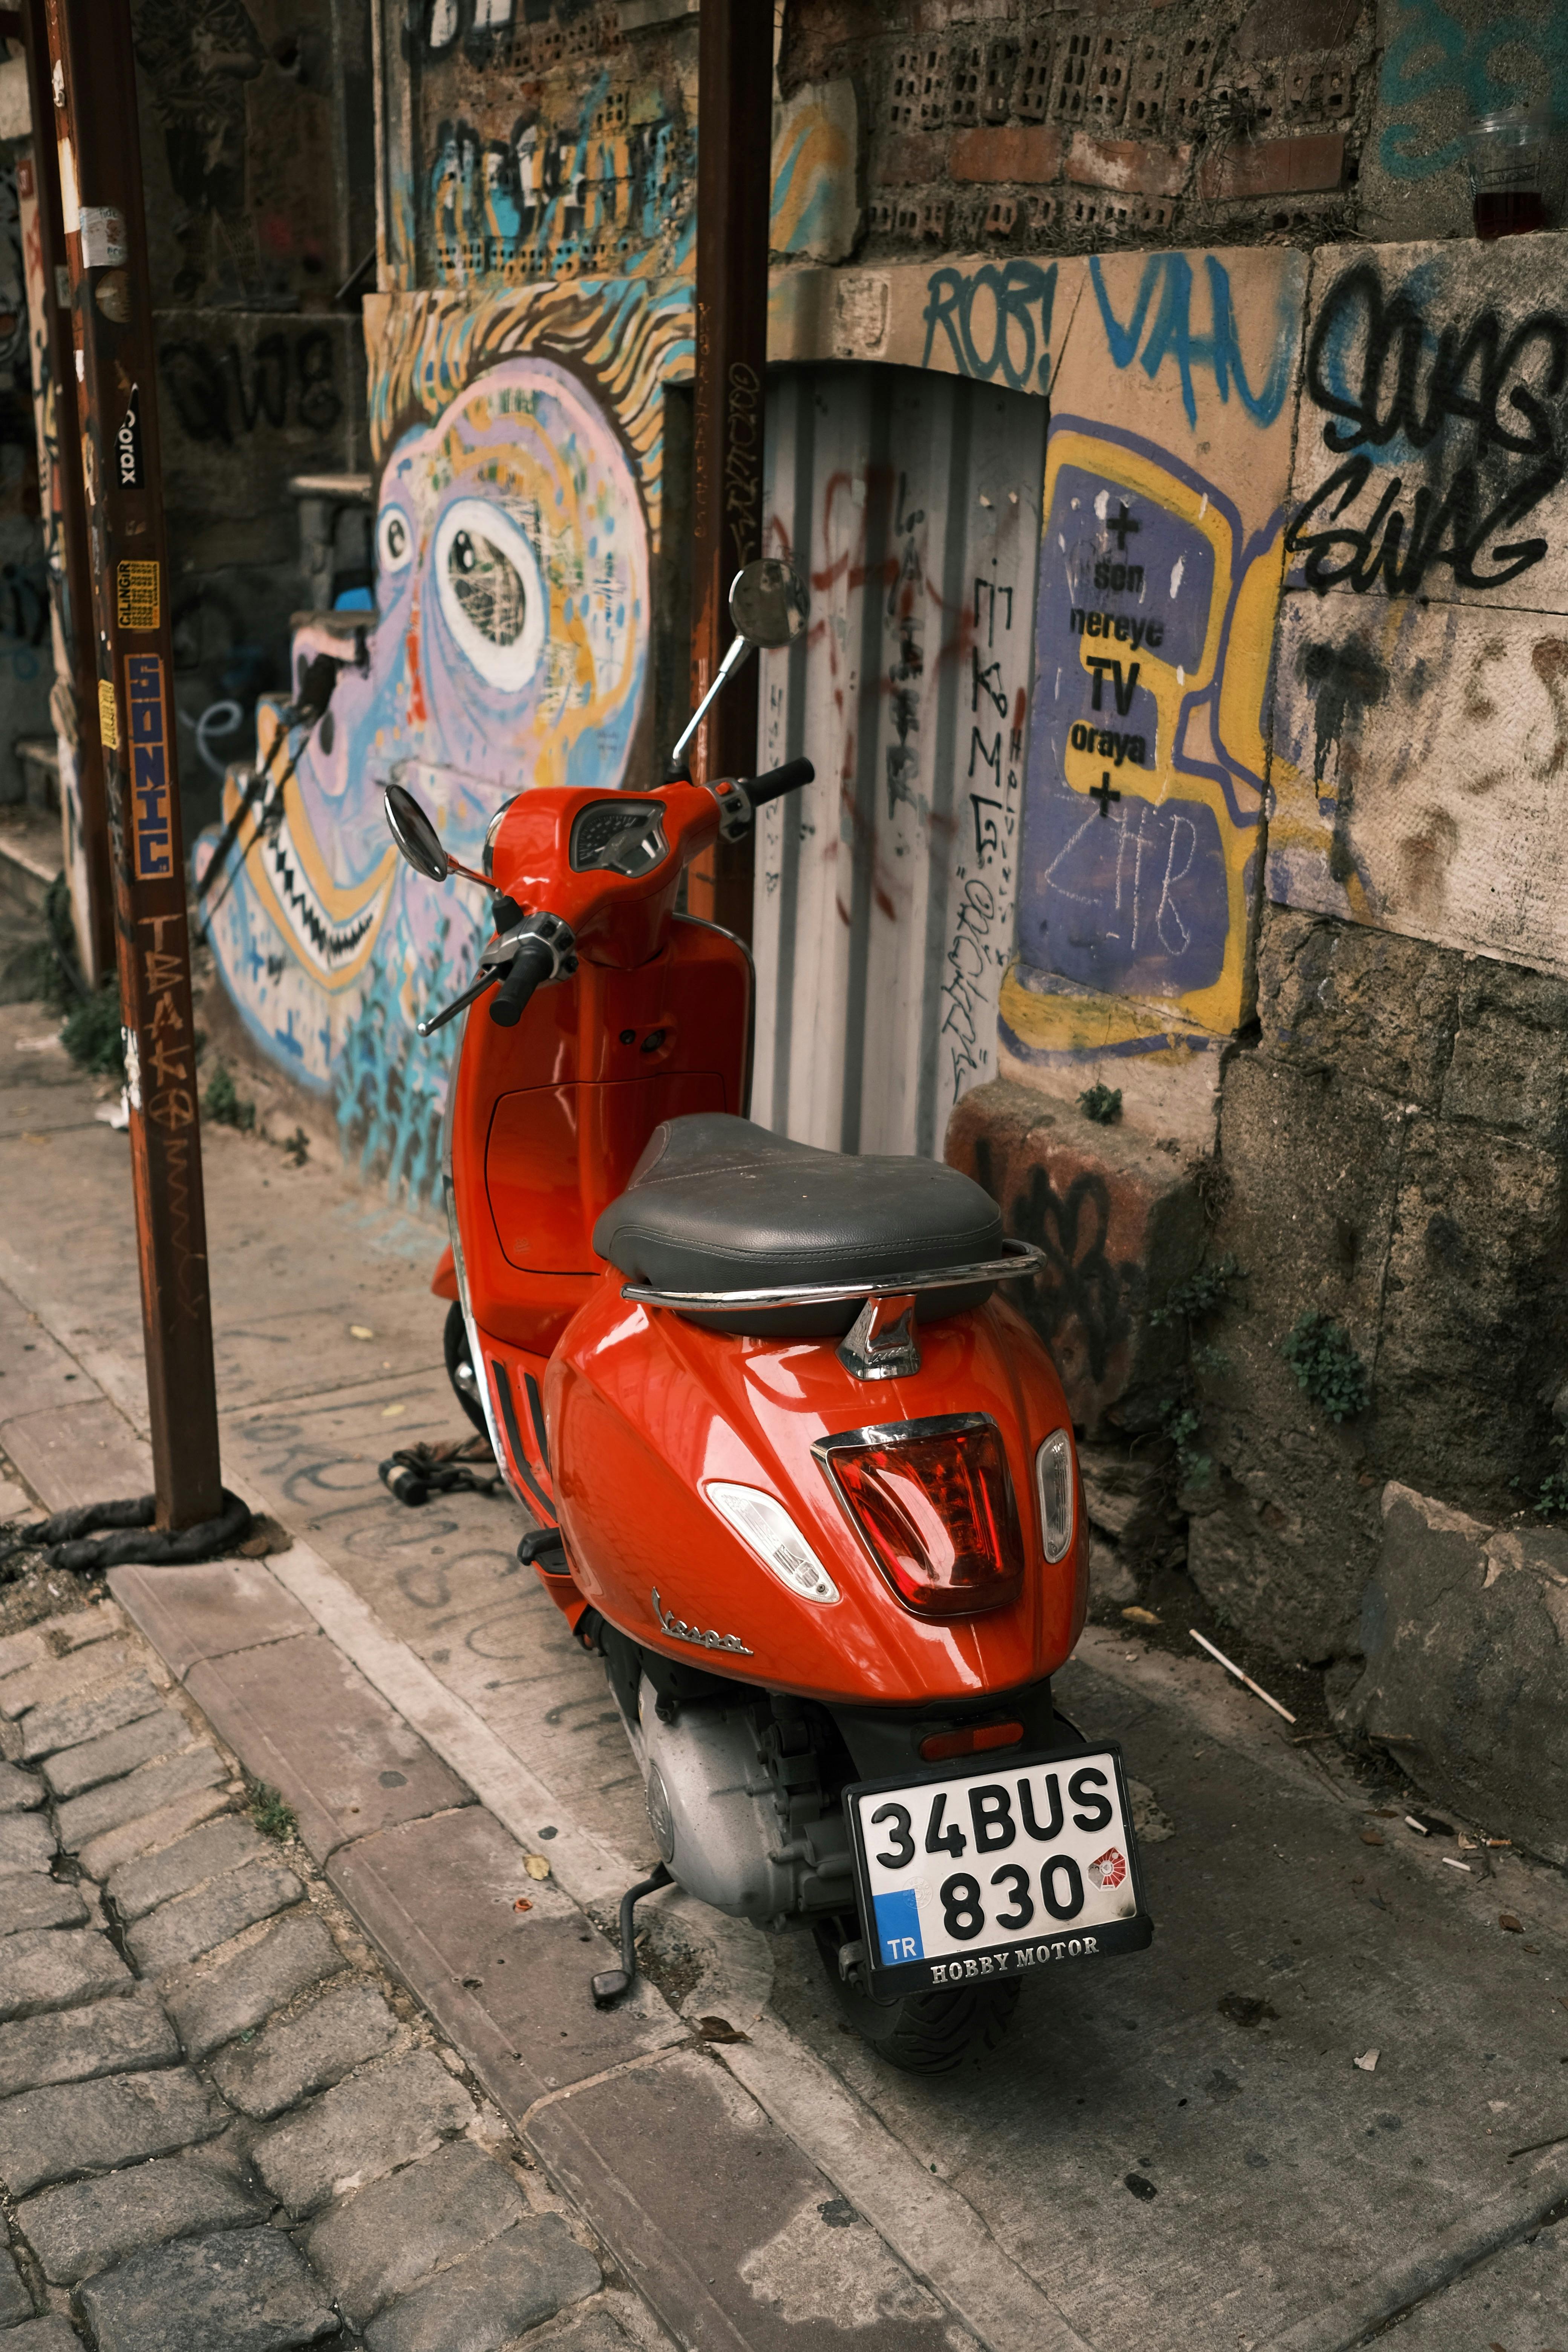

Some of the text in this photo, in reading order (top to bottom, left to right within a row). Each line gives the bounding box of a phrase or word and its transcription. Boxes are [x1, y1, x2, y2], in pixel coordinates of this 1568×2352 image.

[1284, 454, 1563, 596] SWAG
[1093, 560, 1145, 593] sen
[1070, 608, 1164, 650] nereye
[1086, 656, 1140, 716] TV
[129, 656, 171, 873] SONIC
[1071, 724, 1146, 766] oraya
[651, 1586, 754, 1655] Vespa
[940, 1854, 1085, 1941] 830
[887, 1937, 917, 1960] TR
[931, 1936, 1100, 1985] HOBBY MOTOR
